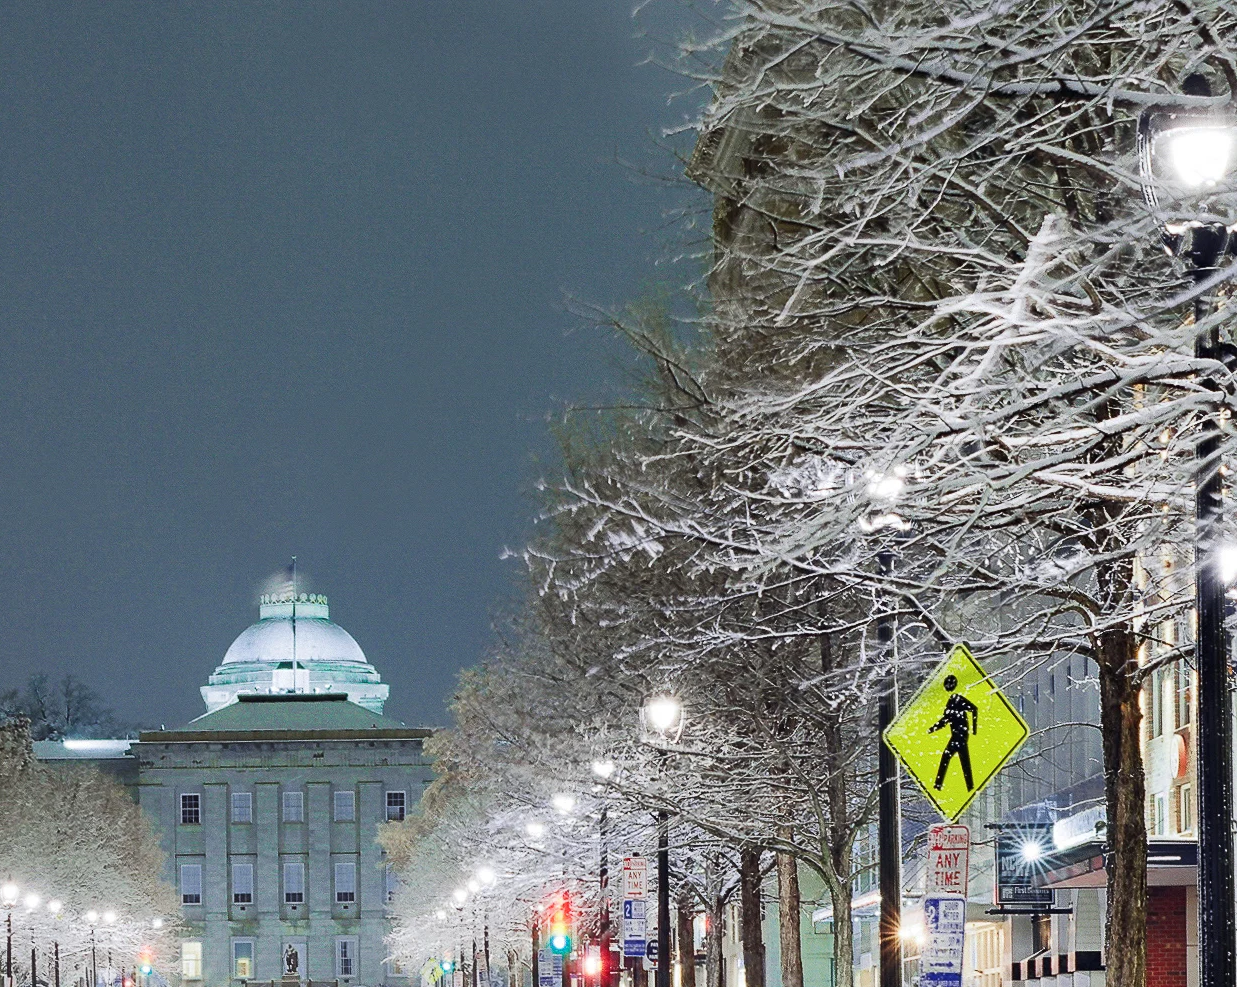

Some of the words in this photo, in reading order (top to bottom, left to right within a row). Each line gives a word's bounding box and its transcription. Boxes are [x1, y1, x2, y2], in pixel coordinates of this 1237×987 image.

[936, 852, 960, 868] ANY
[628, 871, 642, 880] ANY
[935, 871, 961, 886] TIME
[627, 881, 643, 889] TIME
[625, 904, 630, 917] 2
